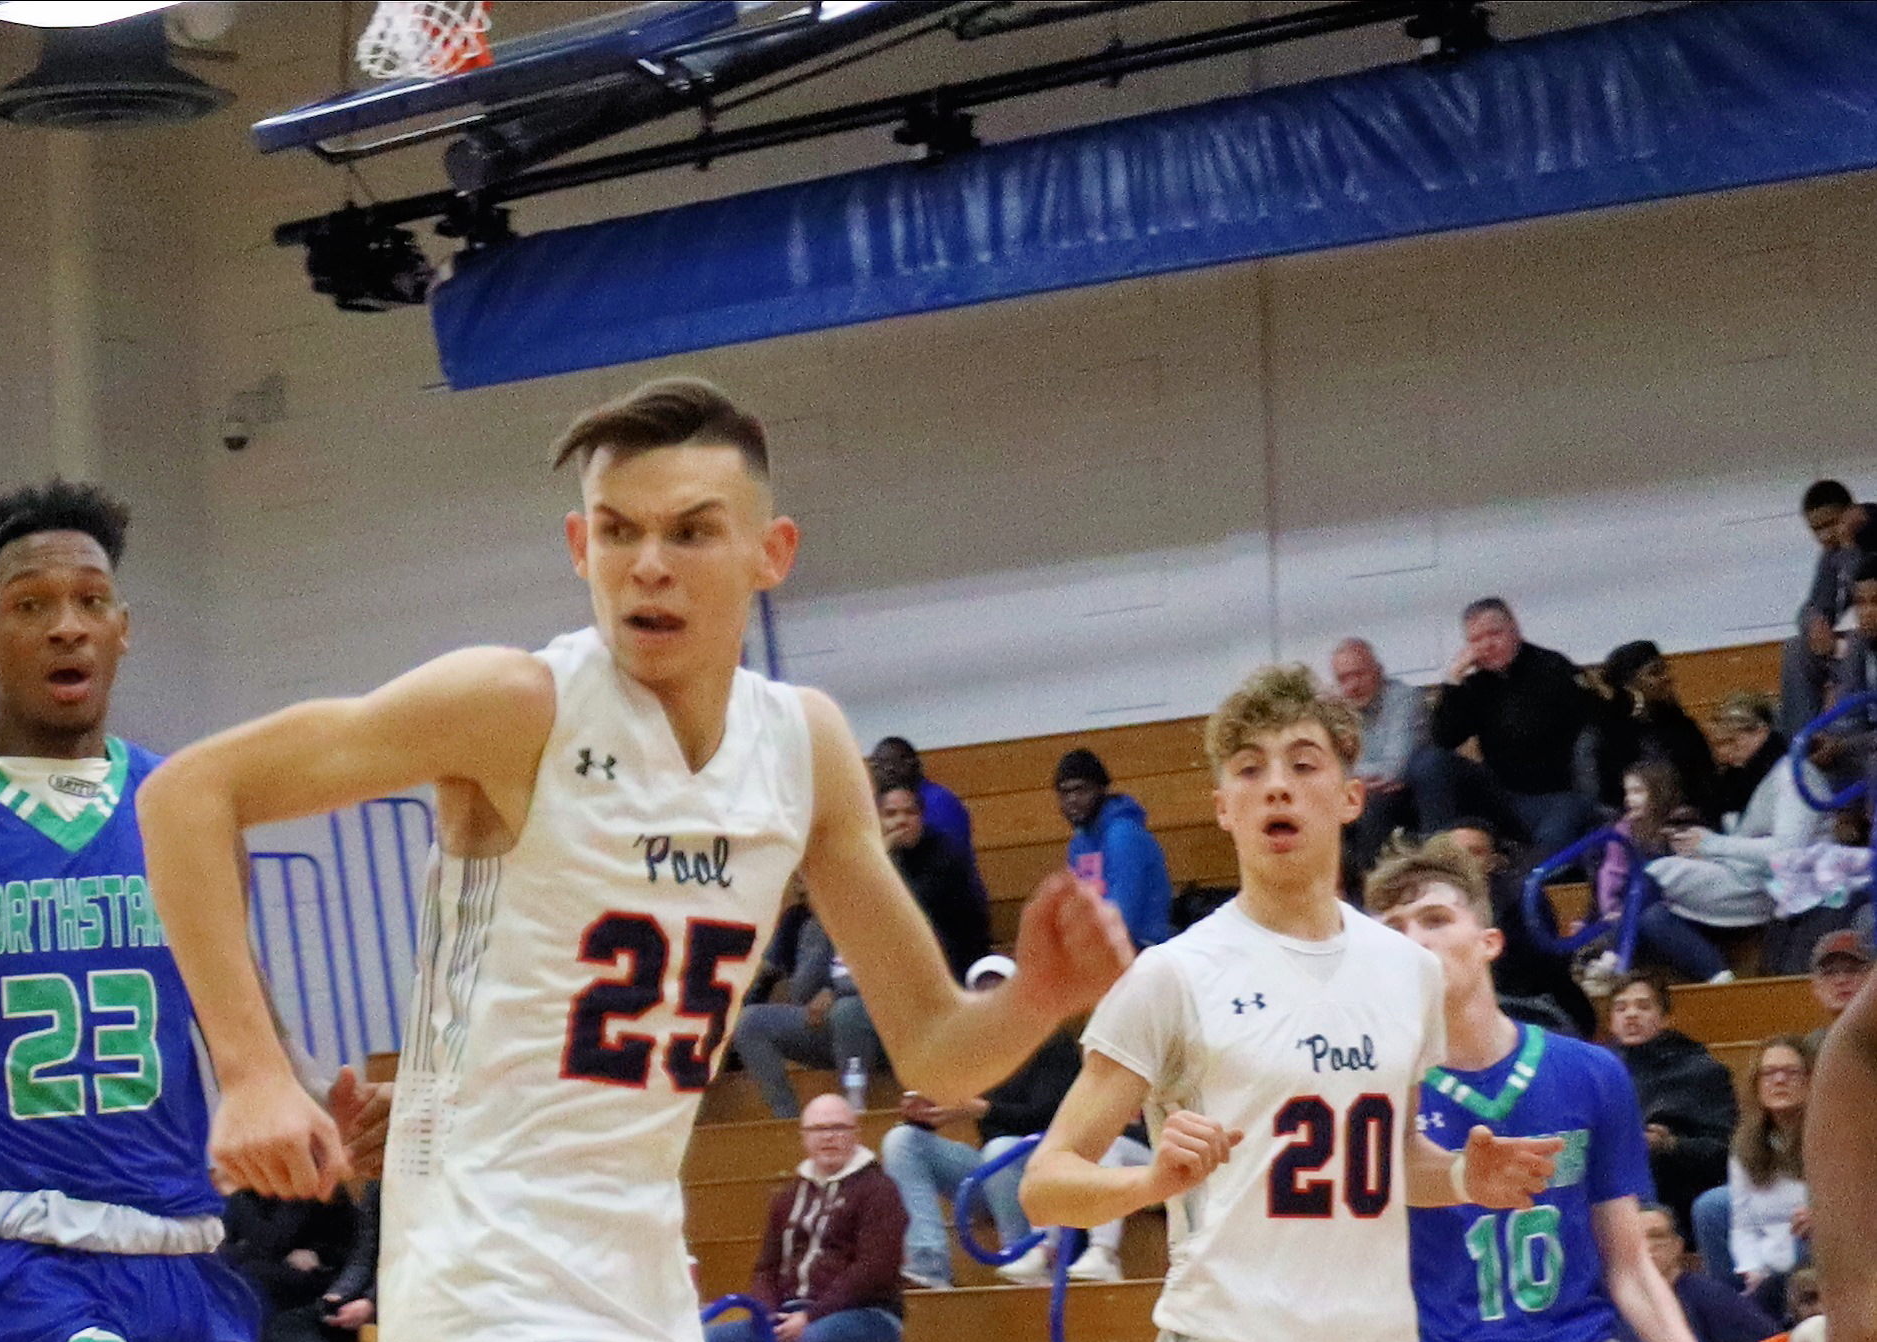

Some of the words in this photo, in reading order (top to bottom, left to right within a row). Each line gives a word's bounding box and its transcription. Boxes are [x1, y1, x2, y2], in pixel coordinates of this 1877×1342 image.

[0, 968, 162, 1121] 23
[559, 910, 756, 1094] 25
[1266, 1092, 1394, 1219] 20
[1465, 1204, 1564, 1322] 10
